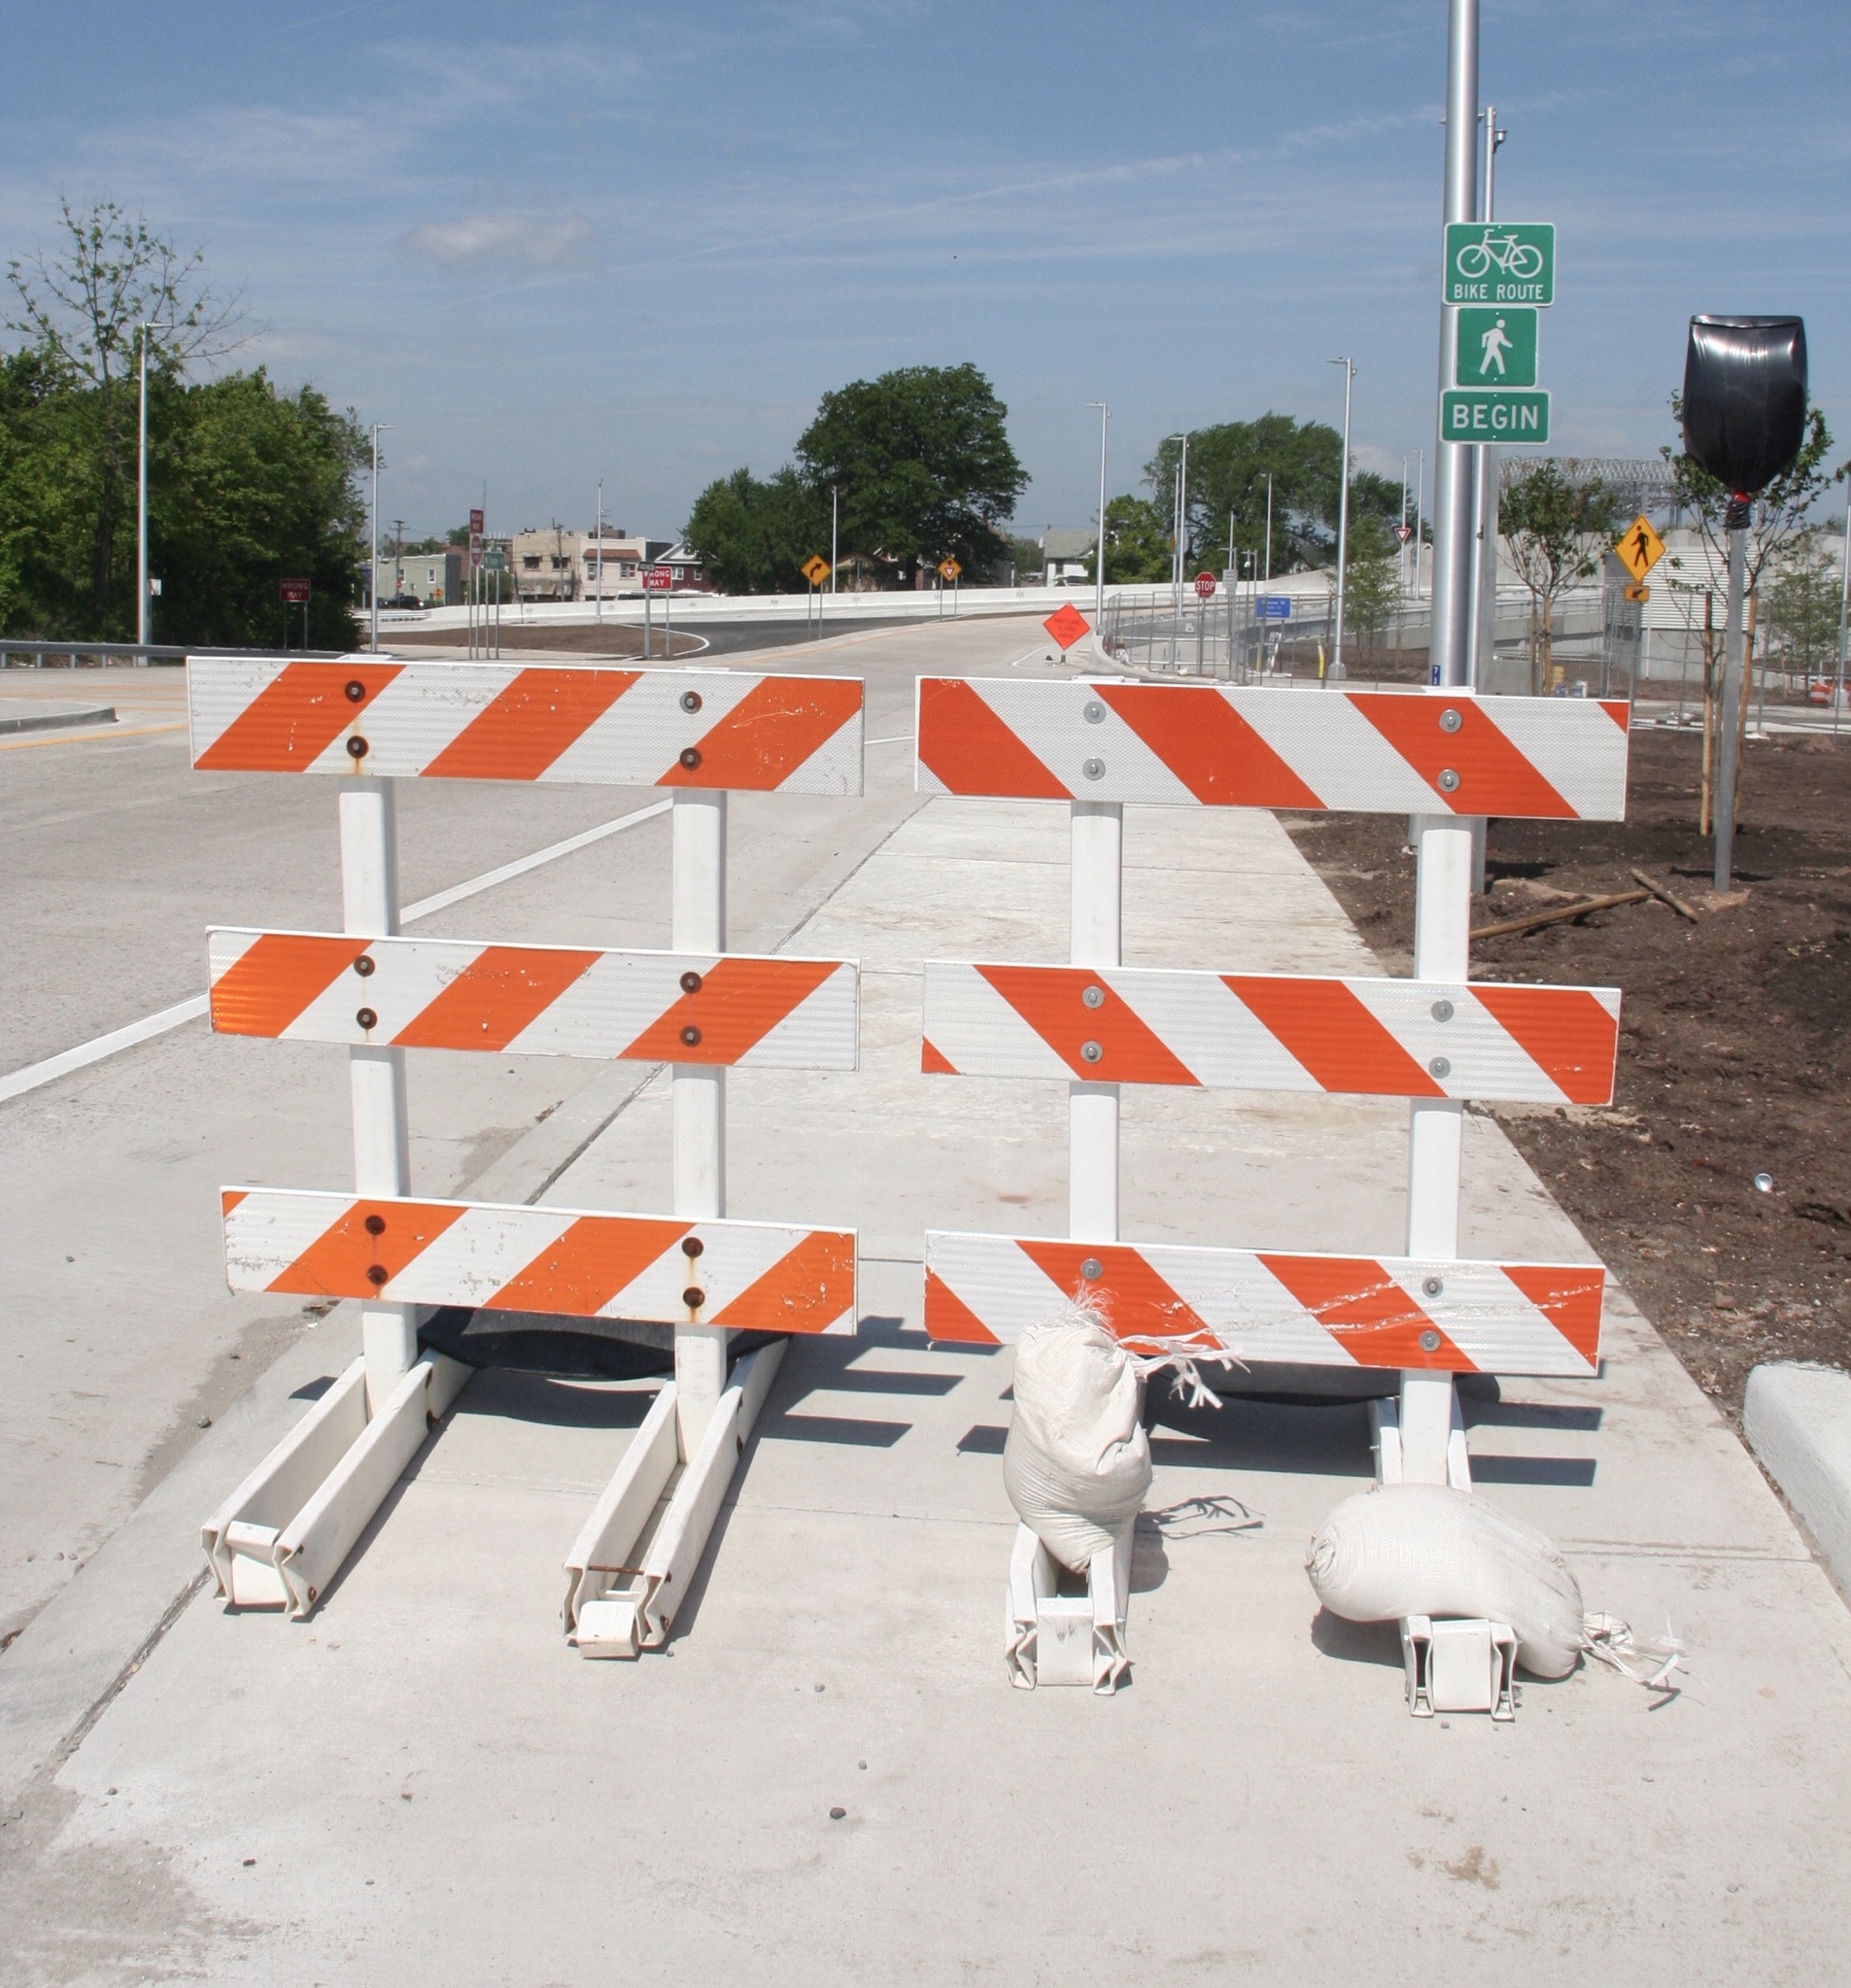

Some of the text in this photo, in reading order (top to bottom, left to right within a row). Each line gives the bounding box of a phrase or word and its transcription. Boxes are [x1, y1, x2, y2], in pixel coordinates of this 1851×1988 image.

[1454, 284, 1544, 300] BIKE ROUTE
[1453, 404, 1538, 429] BEGIN
[1196, 581, 1215, 591] STOP
